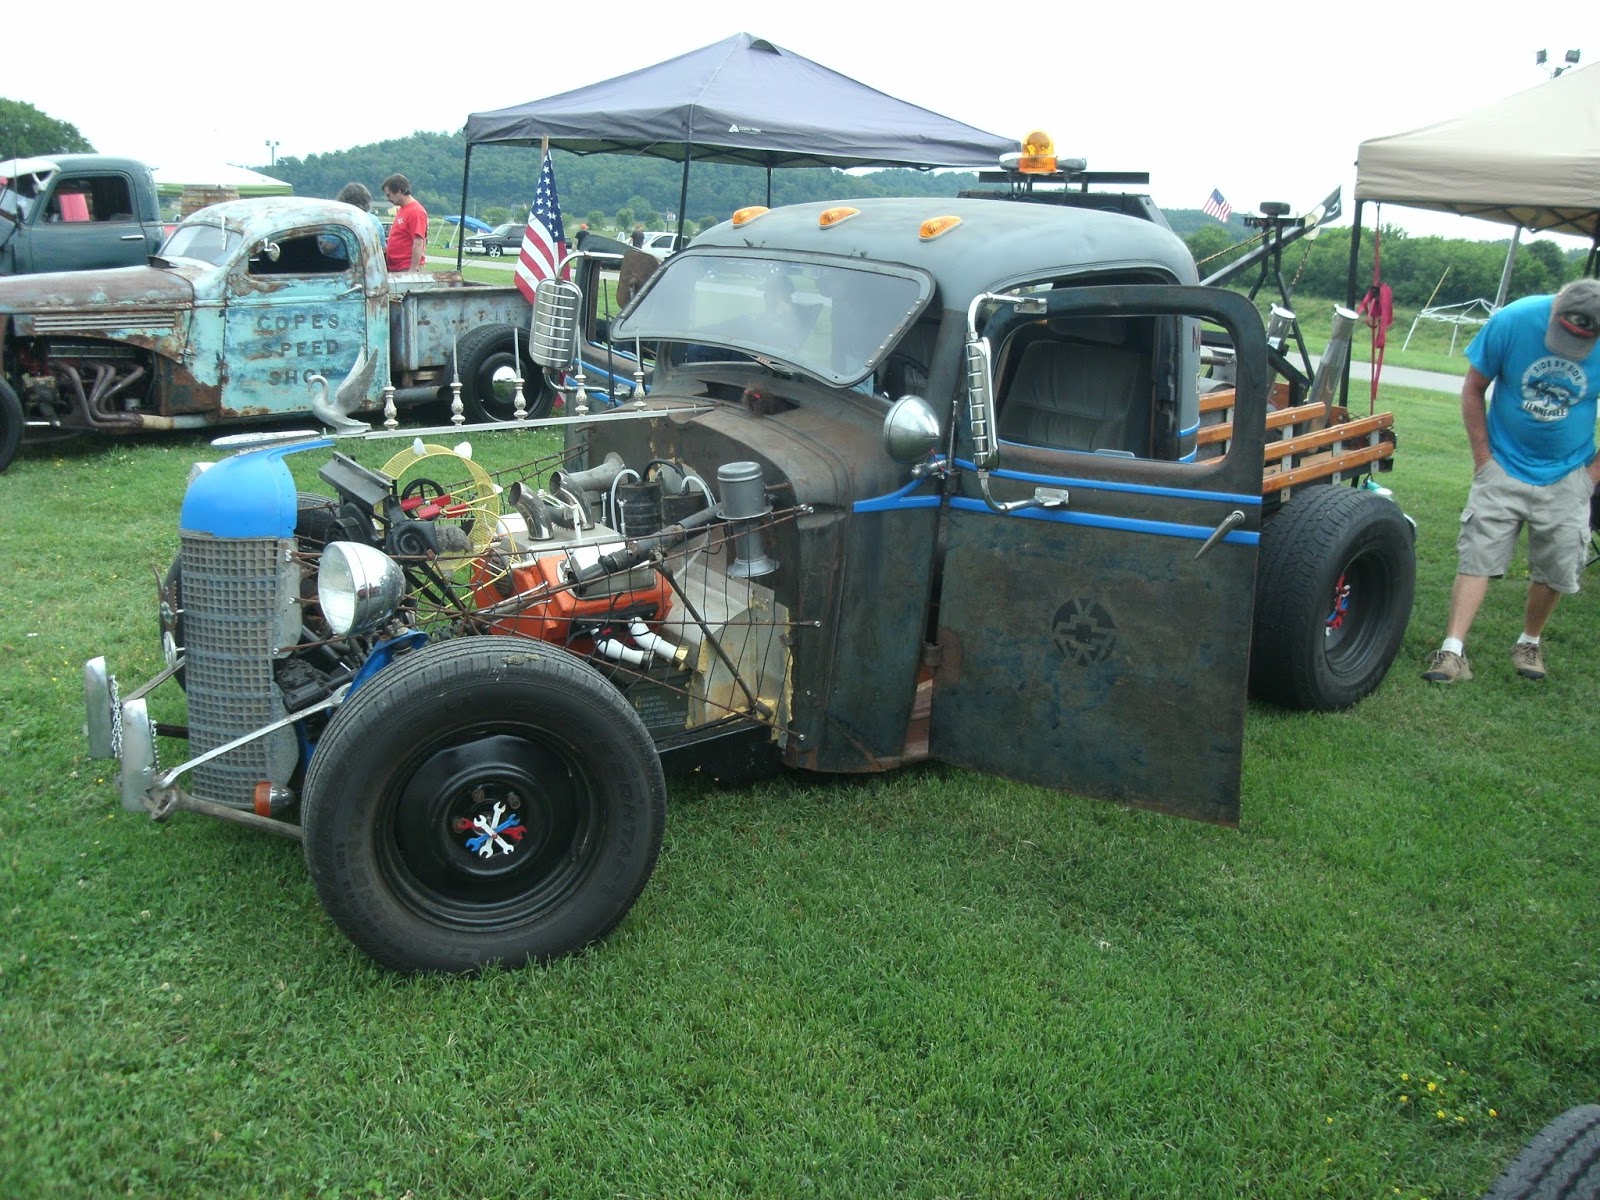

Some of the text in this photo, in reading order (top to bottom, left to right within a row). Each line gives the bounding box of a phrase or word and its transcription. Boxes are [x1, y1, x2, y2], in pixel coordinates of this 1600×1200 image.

[257, 314, 339, 330] COPES
[262, 340, 339, 358] SPEED
[1533, 360, 1582, 382] SIDE BY SIDE
